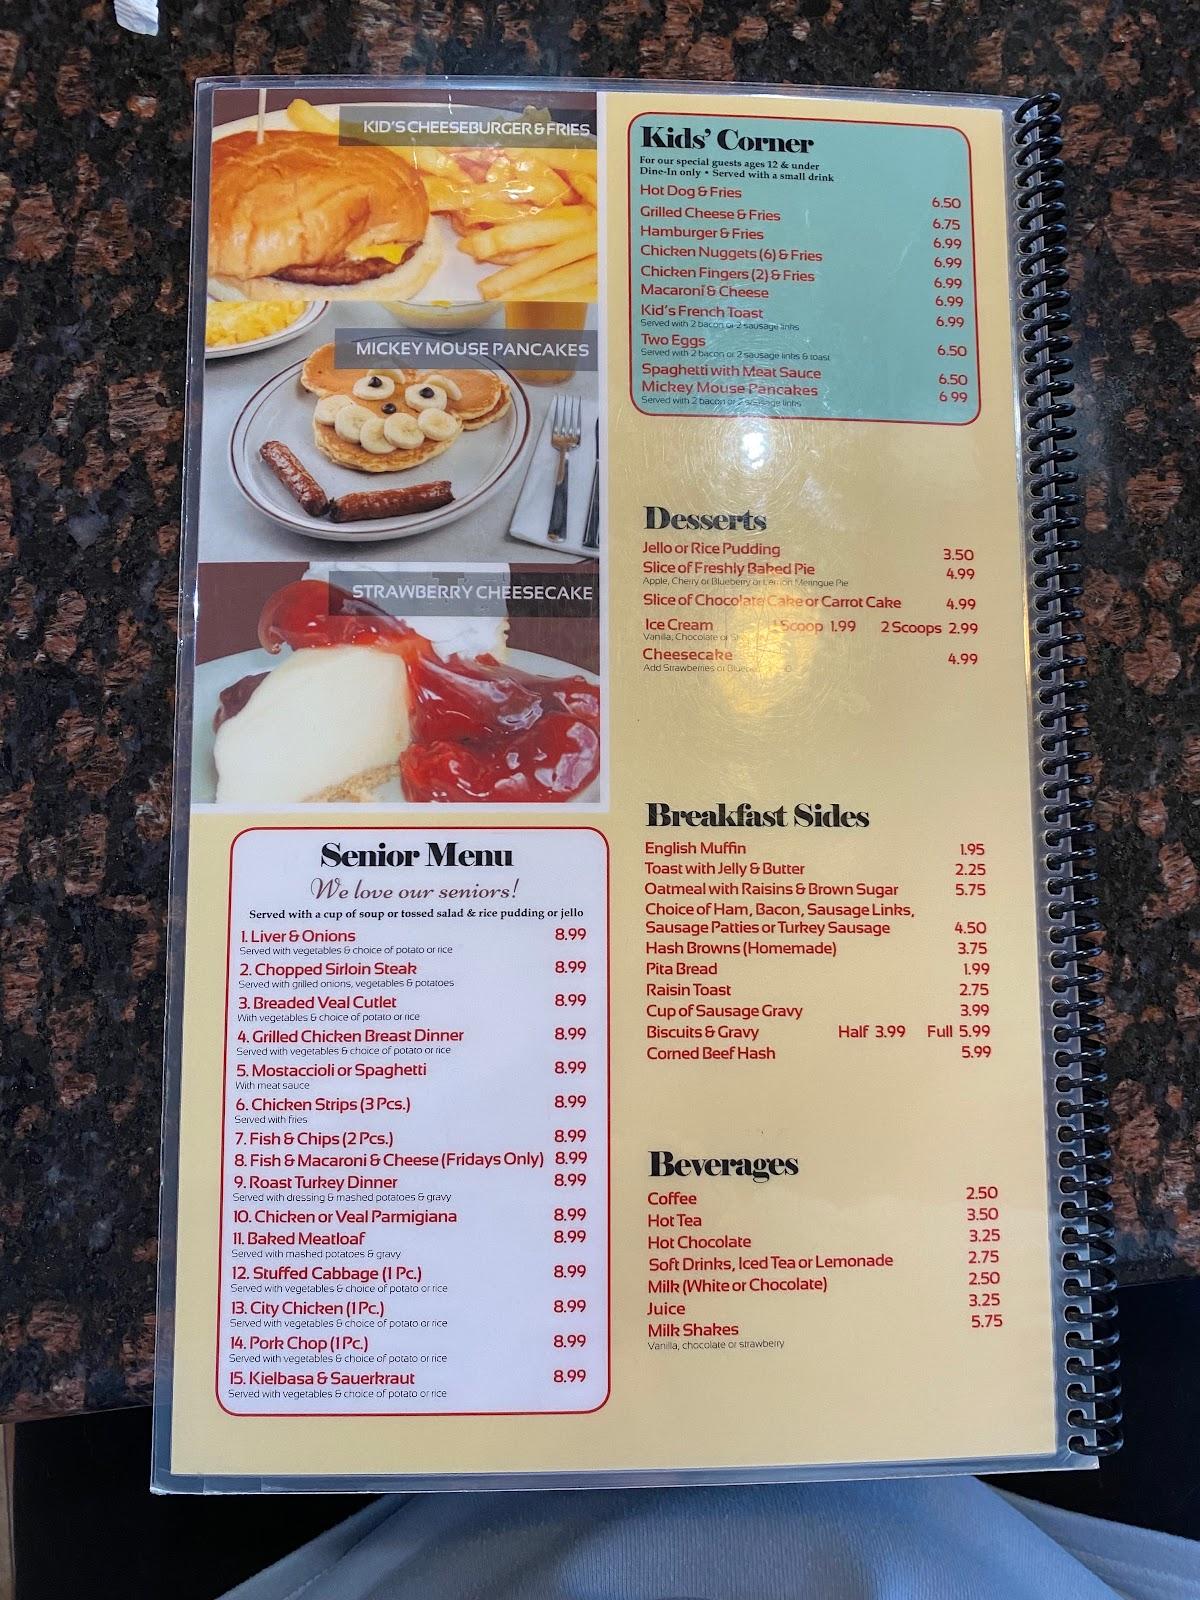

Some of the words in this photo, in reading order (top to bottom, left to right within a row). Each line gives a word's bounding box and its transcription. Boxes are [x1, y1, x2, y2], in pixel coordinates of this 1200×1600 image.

[407, 120, 532, 134] CHEESEBURGER
[533, 122, 545, 135] &
[546, 122, 590, 136] FRIES
[716, 128, 814, 153] Corner
[639, 155, 655, 164] For
[676, 157, 709, 168] special
[711, 159, 742, 169] guests
[743, 161, 765, 170] ages
[767, 160, 778, 168] 12
[780, 160, 790, 169] &
[791, 161, 819, 170] under
[640, 184, 664, 195] Hot
[666, 184, 695, 199] Dog
[697, 186, 708, 196] &
[709, 186, 741, 198] Fries
[931, 197, 961, 208] 6.50
[640, 283, 705, 296] Macaroni
[706, 285, 717, 296] &
[718, 285, 769, 298] Cheese
[935, 295, 963, 307] 6.99
[643, 333, 669, 345] Two
[671, 334, 706, 350] Eggs
[356, 341, 423, 355] MICKEY
[425, 342, 489, 356] MOUSE
[492, 342, 589, 356] PANCAKES
[936, 345, 967, 356] 6.50
[641, 363, 708, 378] Spaghetti
[710, 365, 740, 376] with
[742, 365, 777, 377] Meat
[778, 366, 821, 379] Sauce
[938, 373, 968, 385] 6.50
[643, 506, 767, 531] Desserts
[642, 542, 673, 553] Jello
[674, 544, 688, 554] or
[690, 542, 720, 554] Rice
[722, 542, 780, 557] Pudding
[943, 549, 974, 560] 3.50
[642, 562, 676, 573] Slice
[677, 562, 692, 573] of
[694, 562, 745, 578] Freshly
[747, 563, 791, 574] Baked
[794, 563, 815, 575] Pie
[946, 568, 975, 579] 4.99
[352, 584, 472, 599] STRAWBERRY
[476, 585, 592, 600] CHEESECAKE
[881, 621, 889, 632] 2
[891, 621, 942, 636] Scoops
[948, 622, 978, 634] 2.99
[645, 802, 788, 827] Breakfast
[793, 803, 869, 827] Sides
[320, 842, 420, 867] Senior
[425, 842, 513, 866] Menu
[645, 841, 696, 856] English
[700, 841, 746, 854] Muffin
[960, 843, 984, 855] 1.95
[310, 877, 348, 899] We
[353, 879, 393, 899] love
[398, 889, 434, 898] our
[438, 878, 519, 898] seniors!
[249, 909, 285, 918] Served
[288, 909, 312, 918] with
[323, 911, 342, 921] cup
[345, 908, 357, 918] of
[359, 911, 384, 920] soup
[401, 908, 434, 917] tossed
[436, 908, 464, 917] salad
[466, 908, 476, 917] &
[478, 908, 497, 917] rice
[500, 908, 545, 919] pudding
[560, 908, 583, 919] jello
[241, 930, 247, 942] 1.
[251, 930, 286, 942] Liver
[288, 929, 299, 942] &
[301, 929, 355, 942] Onions
[555, 928, 586, 940] 8.99
[646, 941, 683, 953] Hash
[686, 941, 740, 953] Browns
[742, 941, 836, 956] (Homemade)
[957, 942, 987, 954] 3.75
[239, 963, 251, 975] 2.
[254, 962, 322, 978] Chopped
[325, 962, 371, 975] Sirloin
[373, 962, 417, 974] Steak
[554, 960, 586, 973] 8.99
[237, 1030, 249, 1043] 4.
[252, 1030, 298, 1043] Grilled
[300, 1029, 361, 1042] Chicken
[364, 1029, 412, 1042] Breast
[414, 1028, 464, 1041] Dinner
[554, 1027, 586, 1040] 8.99
[838, 1025, 869, 1037] Half
[875, 1025, 905, 1037] 3.99
[927, 1025, 953, 1037] Full
[959, 1025, 990, 1037] 5.99
[646, 1047, 699, 1059] Corned
[702, 1047, 735, 1059] Beef
[737, 1047, 775, 1059] Hash
[961, 1045, 991, 1058] 5.99
[235, 1081, 255, 1089] With
[234, 1115, 266, 1123] Served
[266, 1115, 287, 1123] with
[288, 1114, 307, 1123] fries
[234, 1154, 247, 1166] 8.
[250, 1154, 281, 1166] Fish
[284, 1153, 295, 1166] &
[297, 1153, 367, 1167] Macaroni
[369, 1153, 381, 1166] &
[383, 1153, 439, 1166] Cheese
[441, 1152, 501, 1169] (Fridays
[503, 1152, 544, 1168] Only)
[554, 1151, 587, 1164] 8.99
[648, 1150, 799, 1183] Beverages
[647, 1191, 697, 1205] Coffee
[966, 1186, 998, 1199] 2.50
[233, 1232, 244, 1244] 11.
[247, 1232, 295, 1245] Baked
[298, 1231, 365, 1245] Meatloaf
[553, 1230, 586, 1243] 8.99
[648, 1235, 674, 1249] Hot
[677, 1234, 751, 1248] Chocolate
[969, 1229, 1000, 1242] 3.25
[649, 1257, 679, 1271] Soft
[682, 1256, 735, 1272] Drinks,
[738, 1256, 768, 1269] Iced
[770, 1255, 796, 1269] Tea
[798, 1258, 813, 1268] or
[815, 1253, 893, 1268] Lemonade
[968, 1250, 999, 1263] 2.75
[968, 1293, 1000, 1306] 3.25
[646, 1301, 685, 1315] Juice
[971, 1315, 1002, 1328] 5.75
[648, 1323, 680, 1337] Milk
[682, 1322, 739, 1336] Shakes
[647, 1341, 681, 1351] Vanilla,
[680, 1340, 726, 1349] chocolate
[738, 1339, 785, 1351] strawberry
[230, 1372, 246, 1384] 15.
[249, 1371, 313, 1384] Kielbasa
[316, 1371, 328, 1384] &
[330, 1371, 414, 1384] Sauerkraut
[553, 1370, 586, 1382] 8.99
